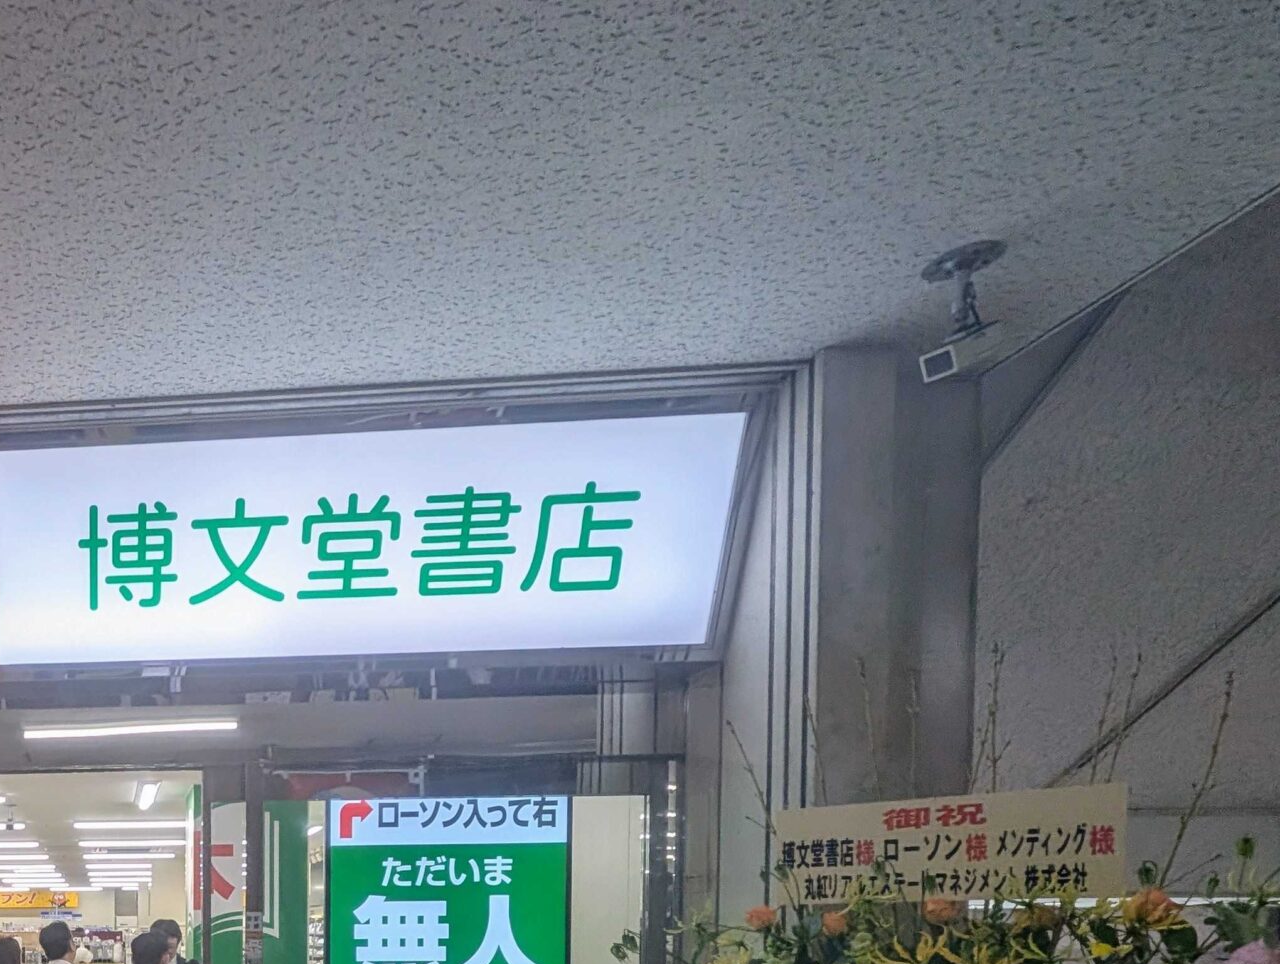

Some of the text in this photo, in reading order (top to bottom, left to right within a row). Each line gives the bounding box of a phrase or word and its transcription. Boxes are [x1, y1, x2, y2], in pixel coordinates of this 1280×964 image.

[78, 481, 641, 611] 博文堂書店
[378, 797, 558, 829] ローソン入って右
[883, 803, 987, 831] 御祝
[782, 839, 875, 869] 博文堂書店様
[883, 833, 988, 862] ローソン様
[382, 856, 513, 887] ただいま
